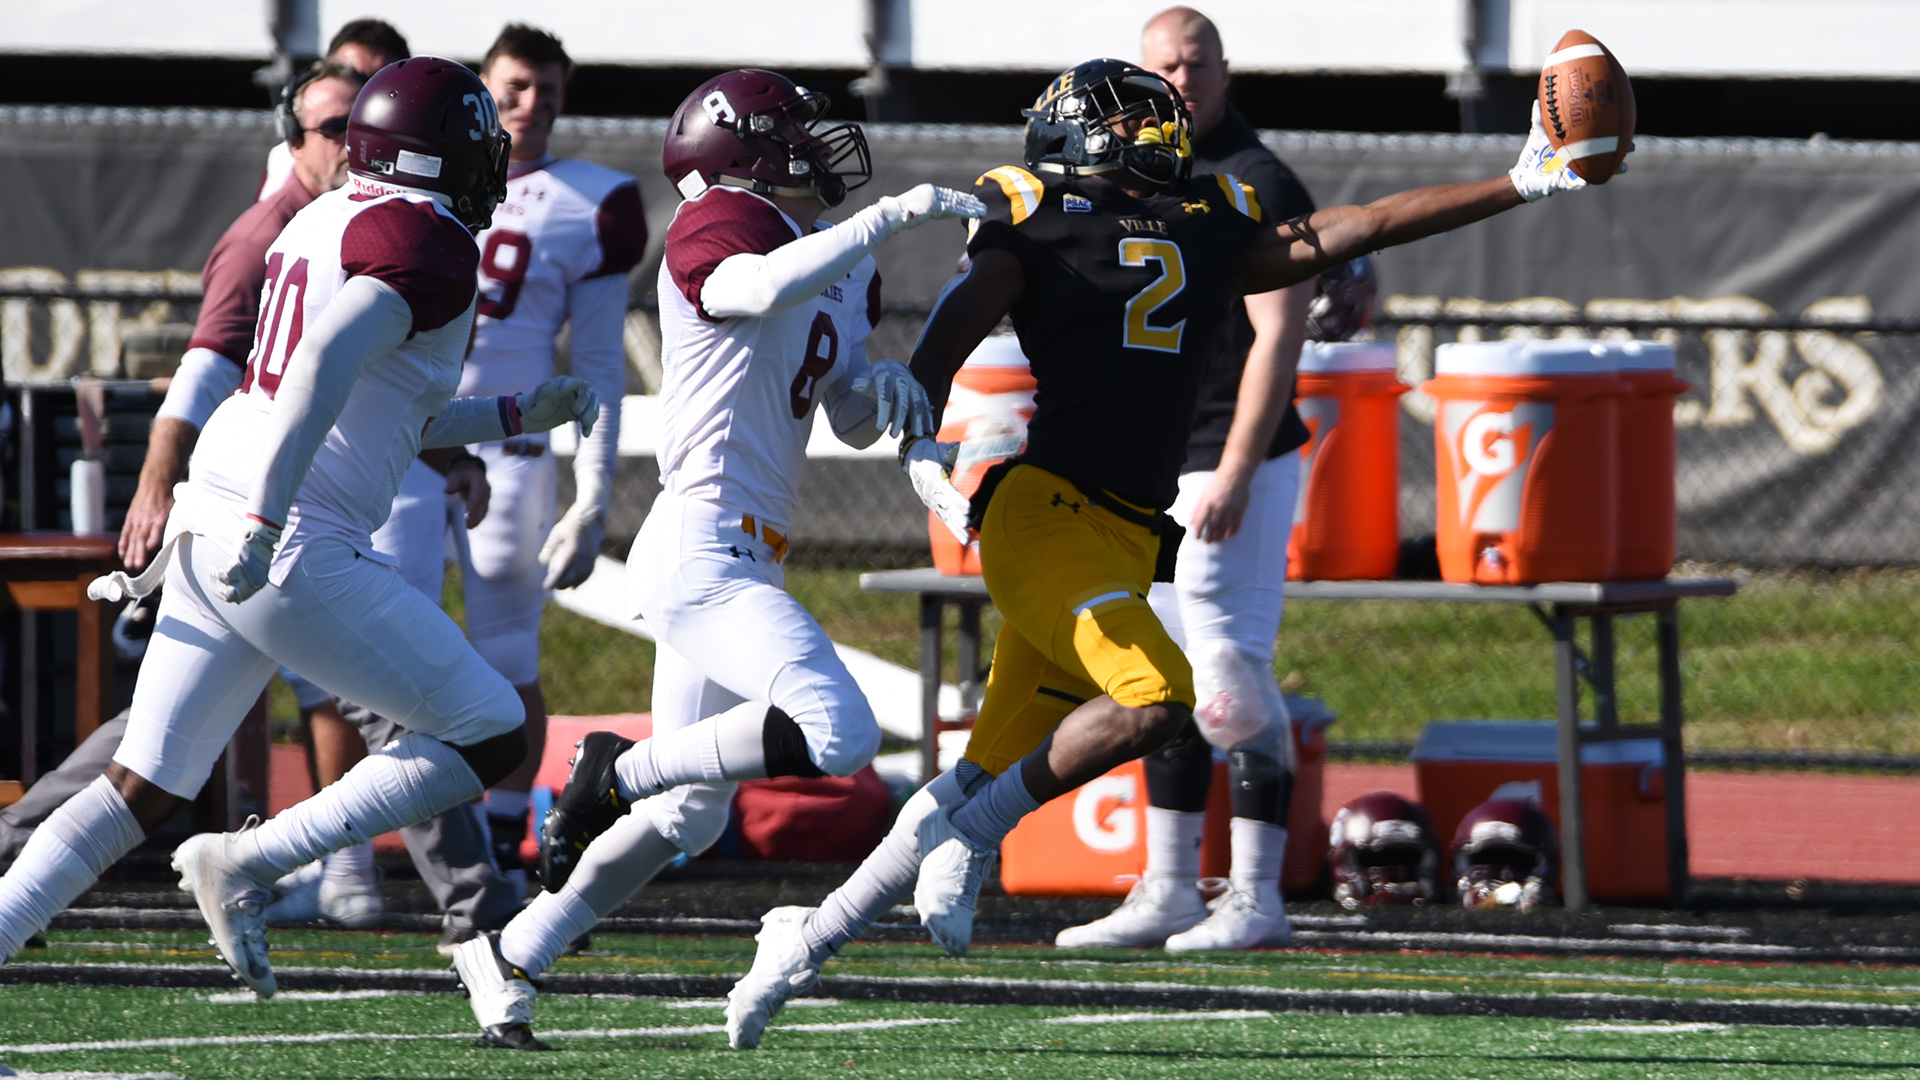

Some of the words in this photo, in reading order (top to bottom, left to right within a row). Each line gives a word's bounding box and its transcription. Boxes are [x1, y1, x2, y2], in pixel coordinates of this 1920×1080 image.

[463, 90, 499, 141] 30
[702, 90, 736, 128] 8
[1568, 69, 1585, 127] Wilson
[353, 178, 408, 196] Ridde
[1118, 218, 1168, 236] VILLE
[820, 284, 844, 303] KIES
[1118, 237, 1188, 354] 2
[790, 310, 838, 419] 8
[1463, 411, 1517, 475] G
[1073, 774, 1137, 853] G
